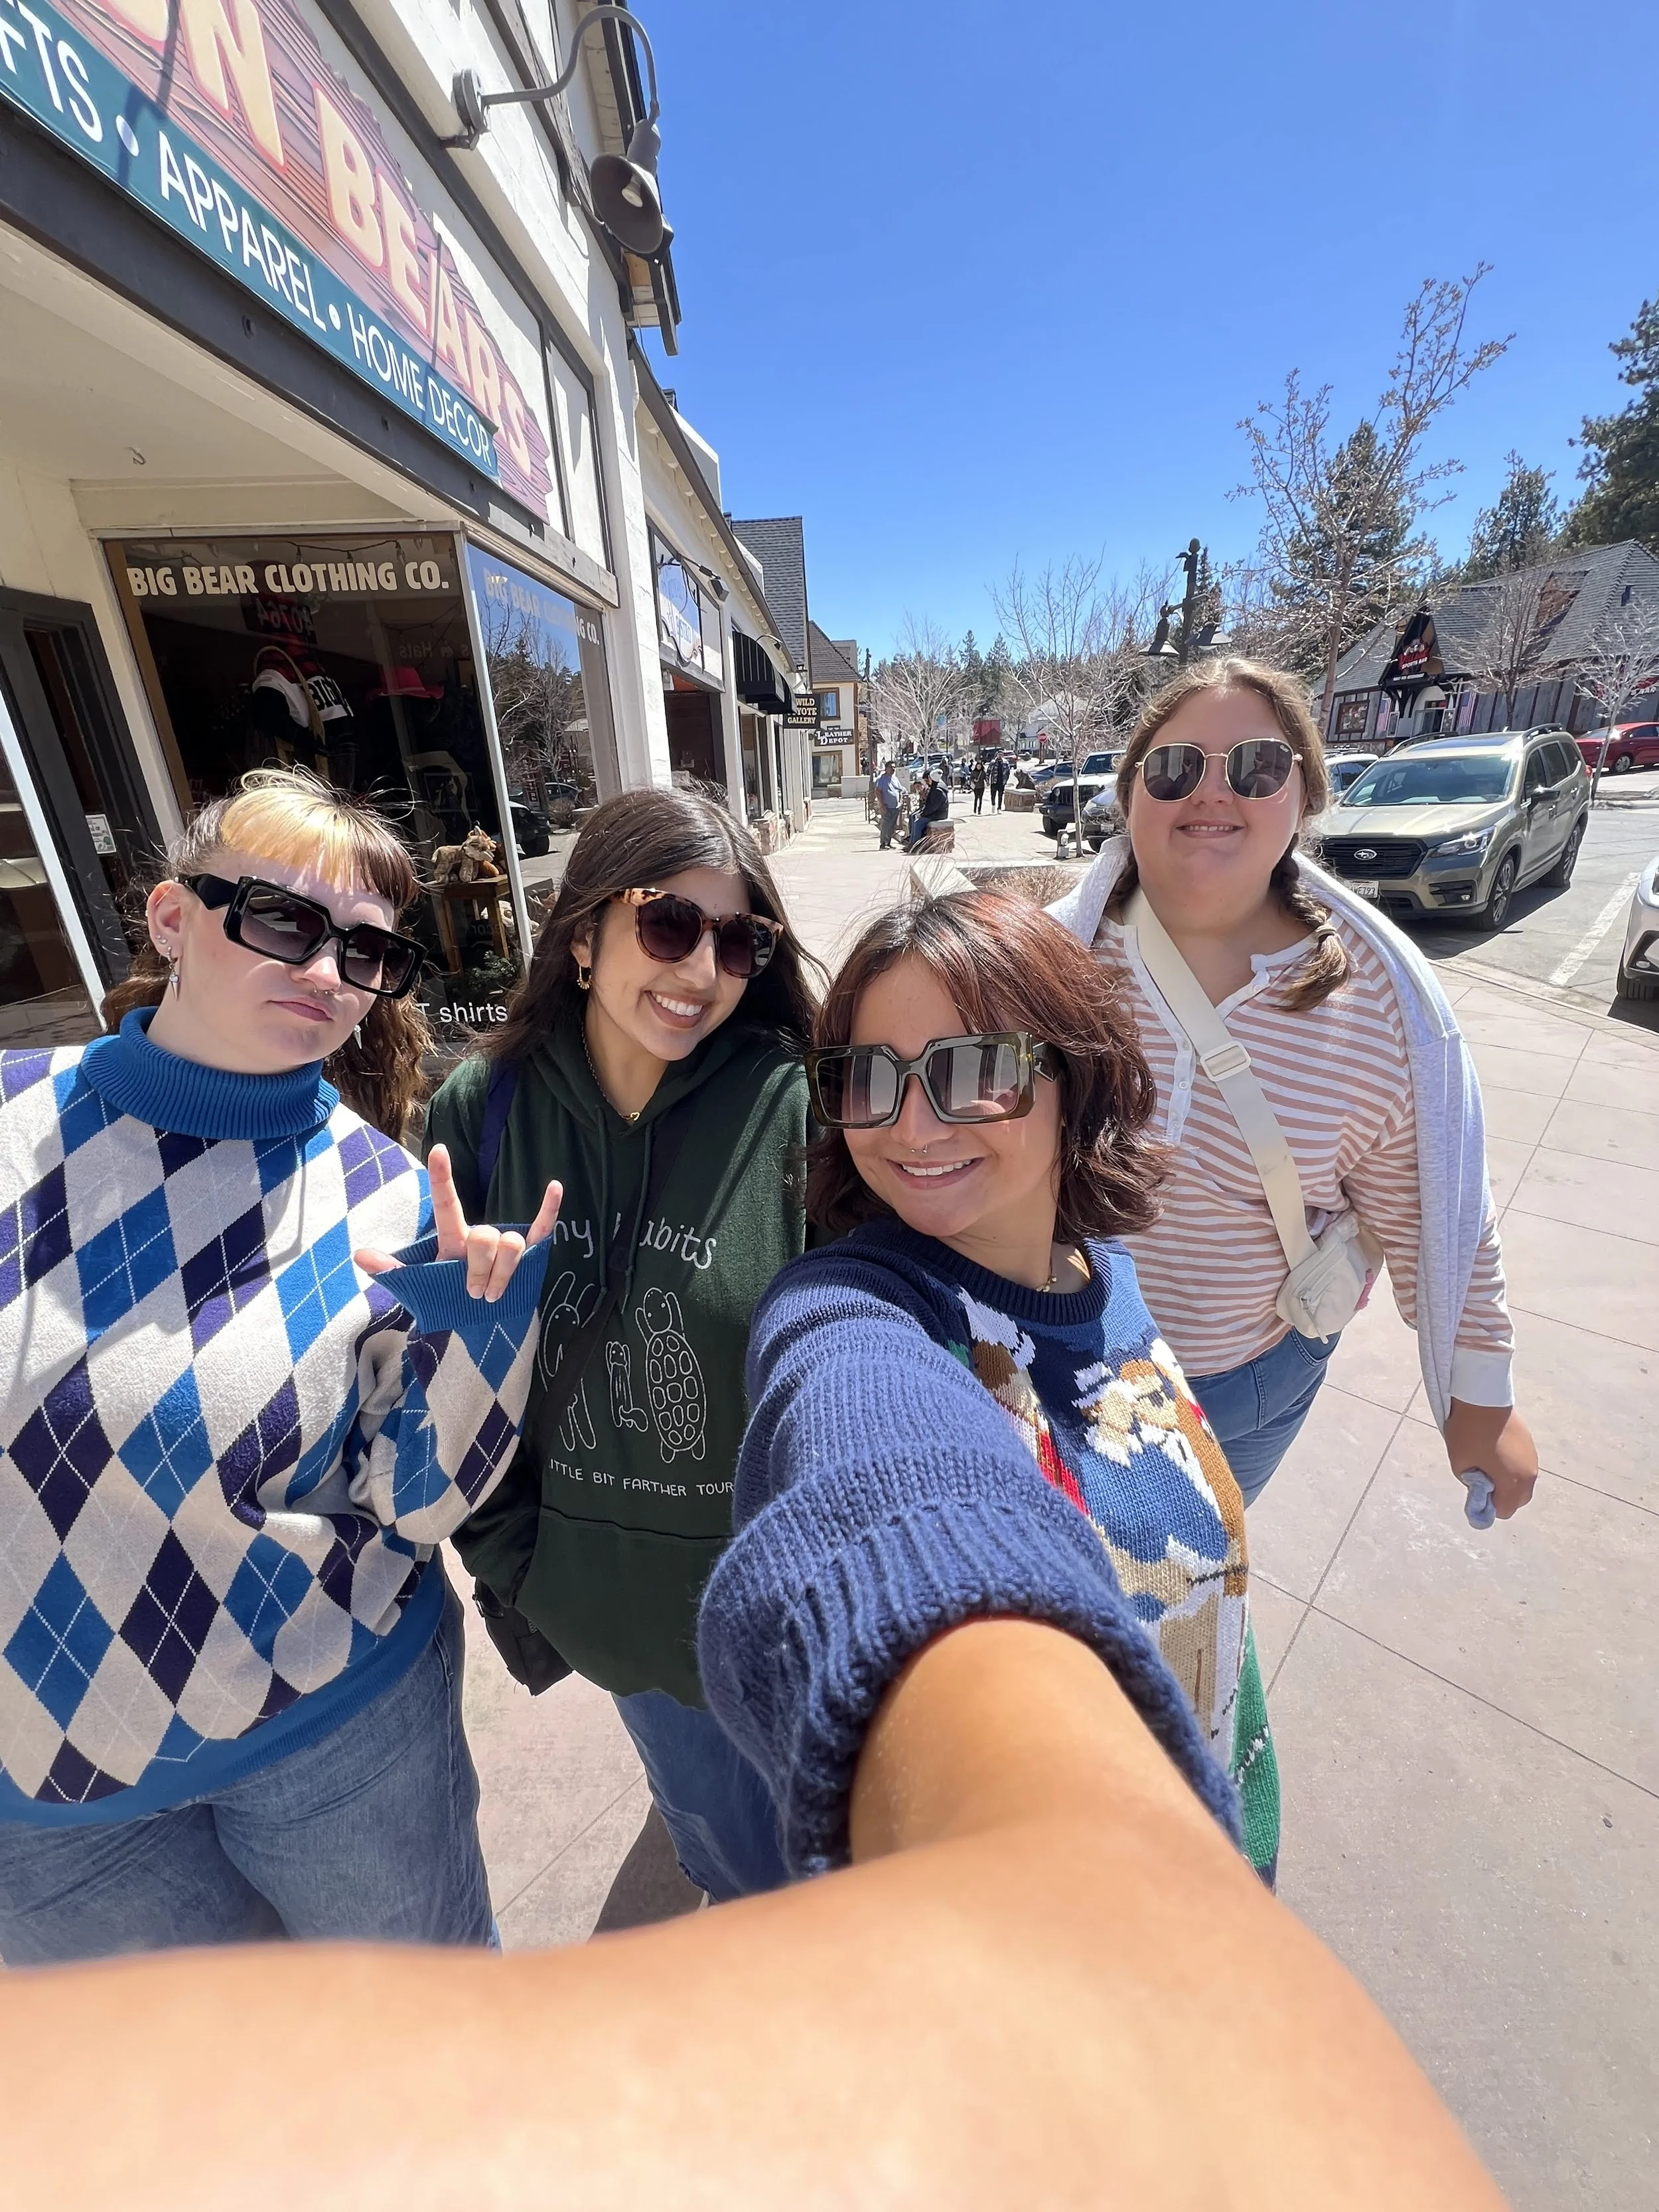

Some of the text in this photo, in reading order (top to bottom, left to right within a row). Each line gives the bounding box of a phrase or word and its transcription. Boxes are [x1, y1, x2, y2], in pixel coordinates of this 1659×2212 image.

[159, 129, 327, 332] APPAREL
[346, 302, 426, 411] HOME
[427, 376, 492, 467] DECOR
[313, 82, 532, 477] BEARS
[126, 560, 450, 597] BIG BEAR CLOTHING CO.
[439, 1001, 508, 1023] shirts
[548, 1458, 735, 1497] ITTLE BIT FARTHER TOUR
